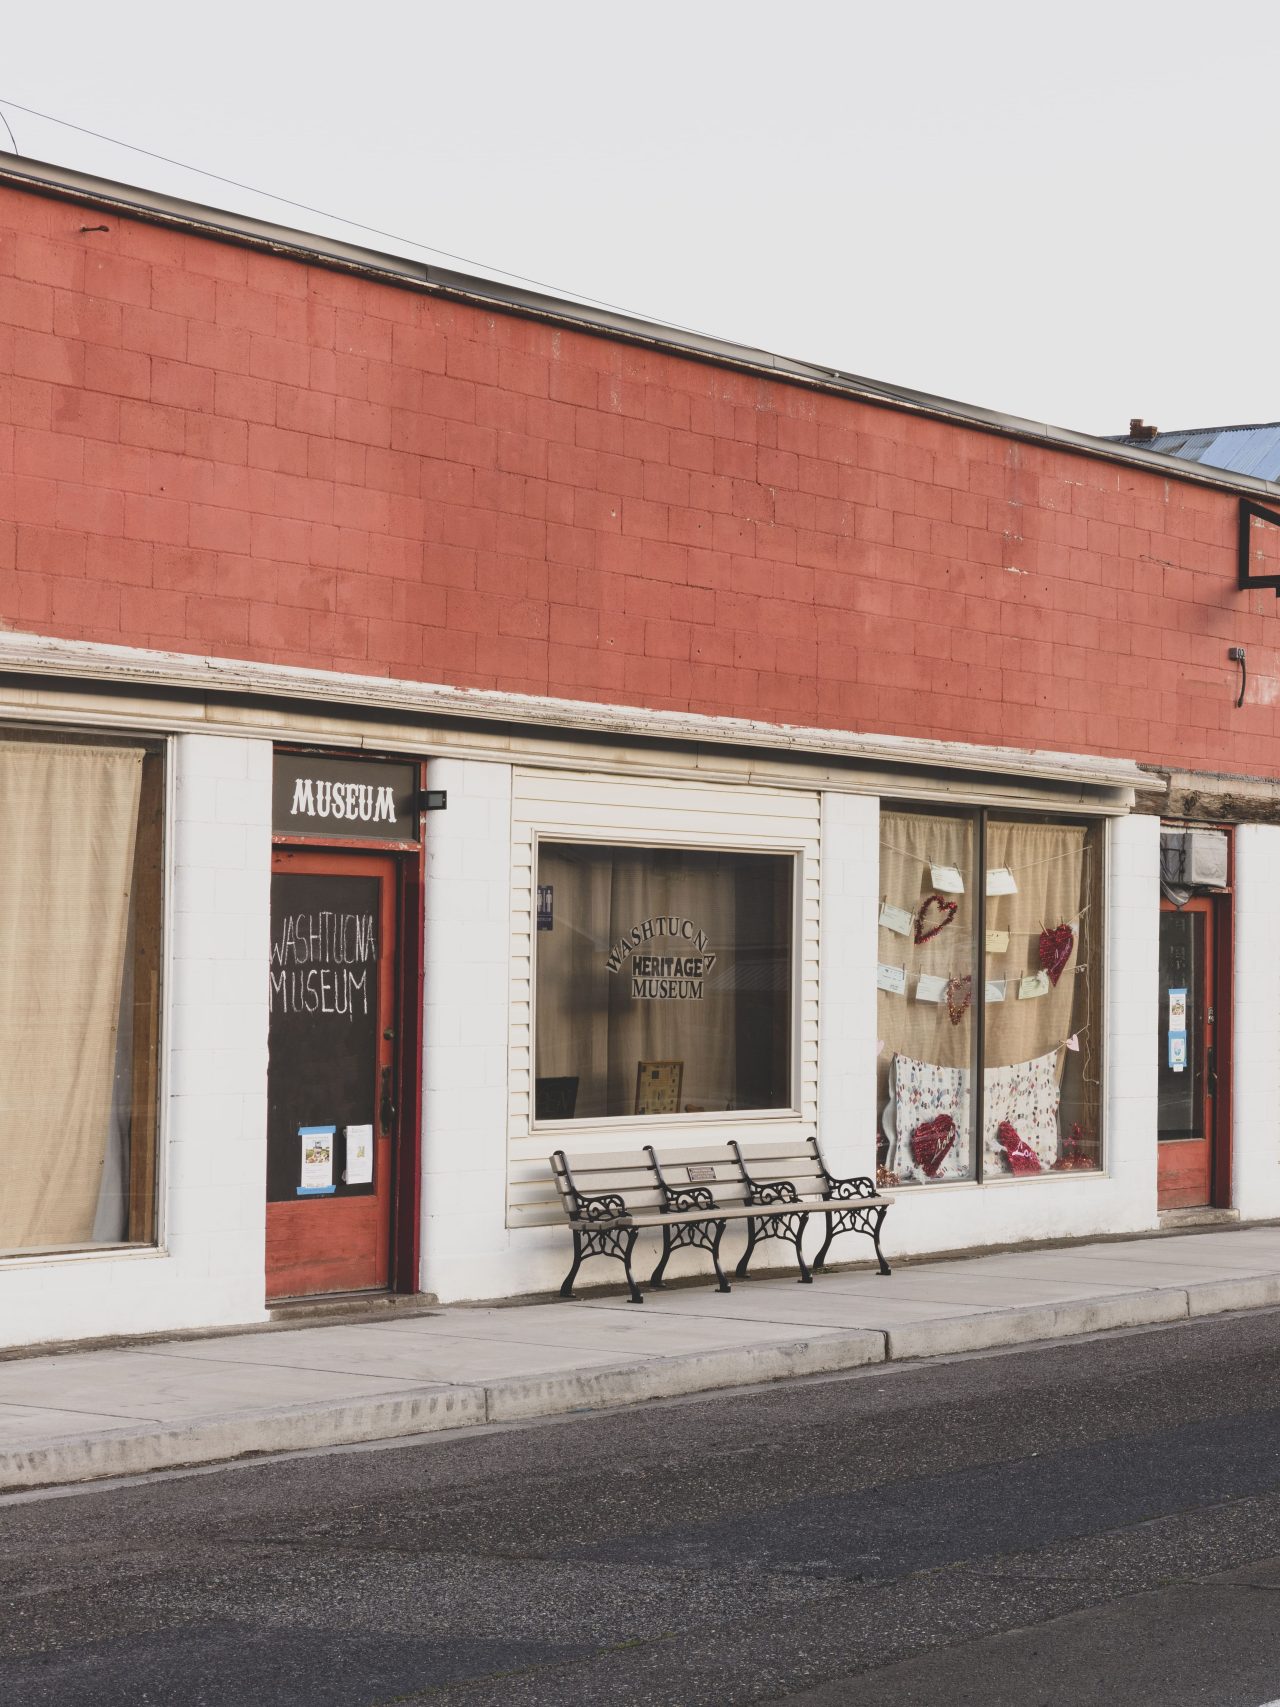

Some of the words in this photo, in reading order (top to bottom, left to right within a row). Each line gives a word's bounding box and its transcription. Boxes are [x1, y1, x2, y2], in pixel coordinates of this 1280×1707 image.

[290, 778, 398, 824] MUSEUM
[605, 916, 717, 974] WASHTUCNA
[632, 955, 704, 978] HERITAGE
[270, 968, 368, 1021] MUSEUM
[632, 979, 704, 999] MUSEUM
